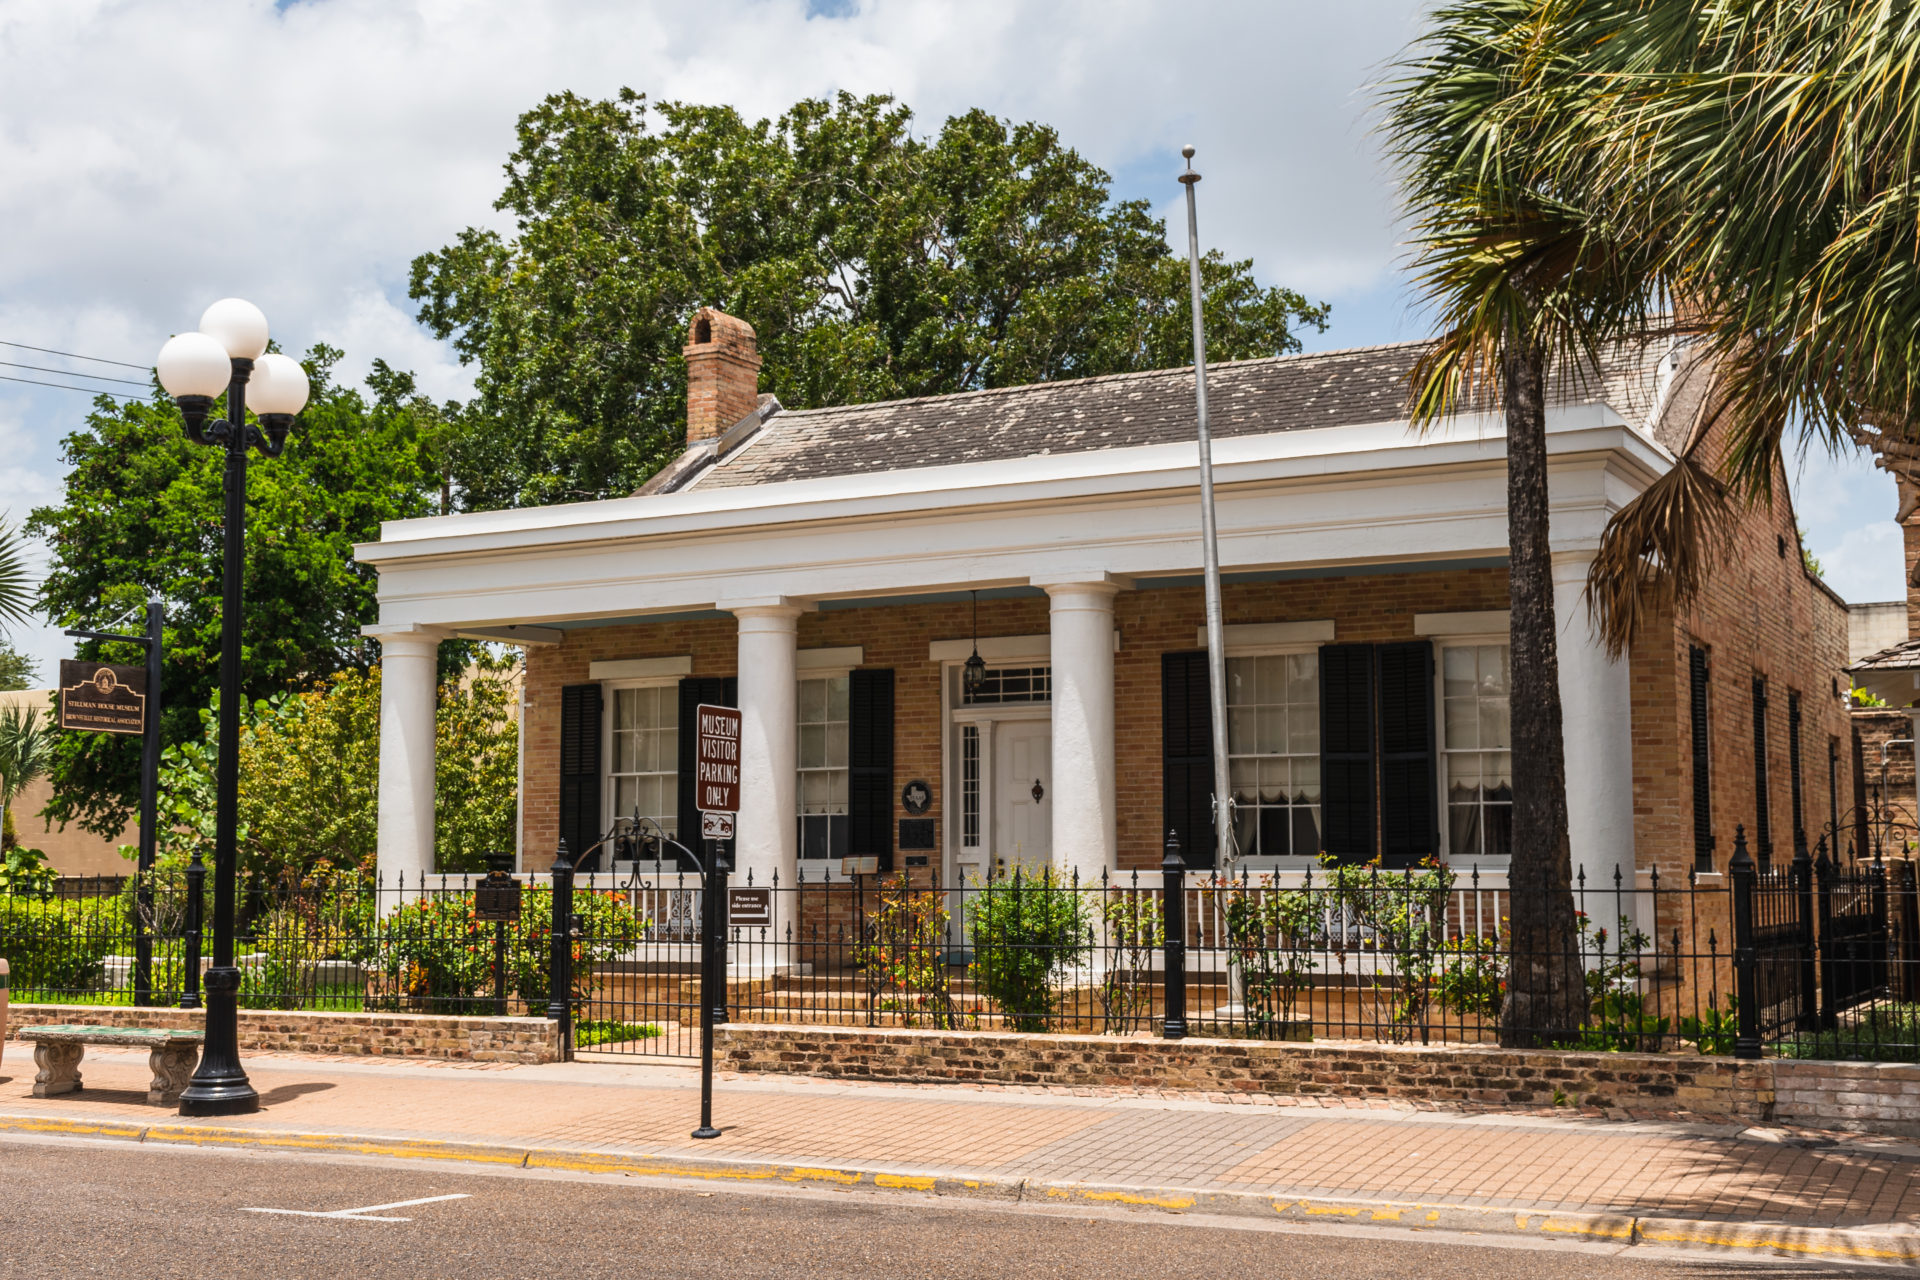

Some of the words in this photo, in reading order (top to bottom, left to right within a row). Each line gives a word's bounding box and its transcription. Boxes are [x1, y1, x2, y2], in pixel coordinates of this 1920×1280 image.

[68, 701, 96, 709] STILLMAN
[98, 703, 115, 711] HOUSE
[702, 714, 738, 736] MUSEUM
[702, 738, 737, 760] VISITOR
[700, 762, 738, 784] PARKING
[706, 786, 730, 807] ONLY
